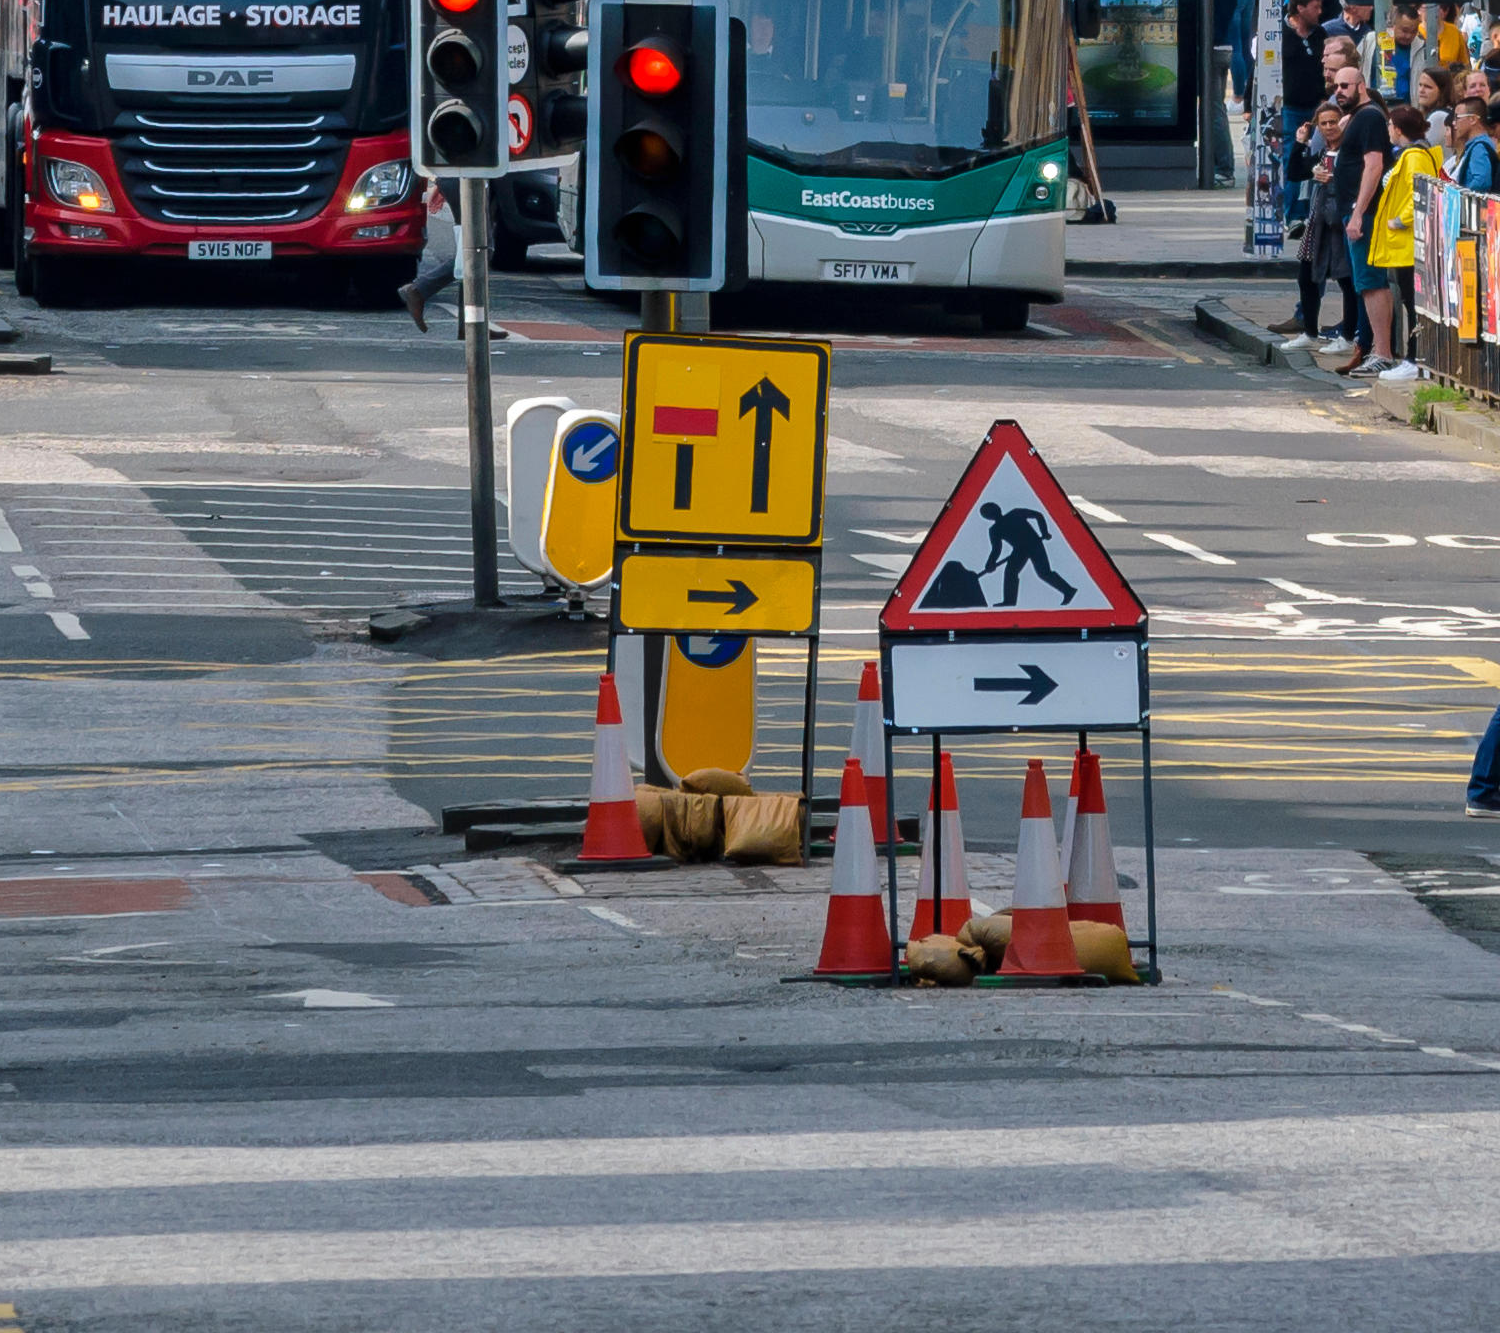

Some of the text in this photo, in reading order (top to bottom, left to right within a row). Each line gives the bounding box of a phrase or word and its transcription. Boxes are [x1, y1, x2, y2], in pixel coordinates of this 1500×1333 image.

[103, 4, 361, 26] HAULAGE STORAGE
[507, 42, 527, 54] cept
[508, 58, 526, 69] cles
[187, 70, 273, 86] DAF
[801, 189, 935, 211] EastCoastbuses
[198, 243, 231, 257] SV15
[833, 263, 899, 280] SF17 VMA
